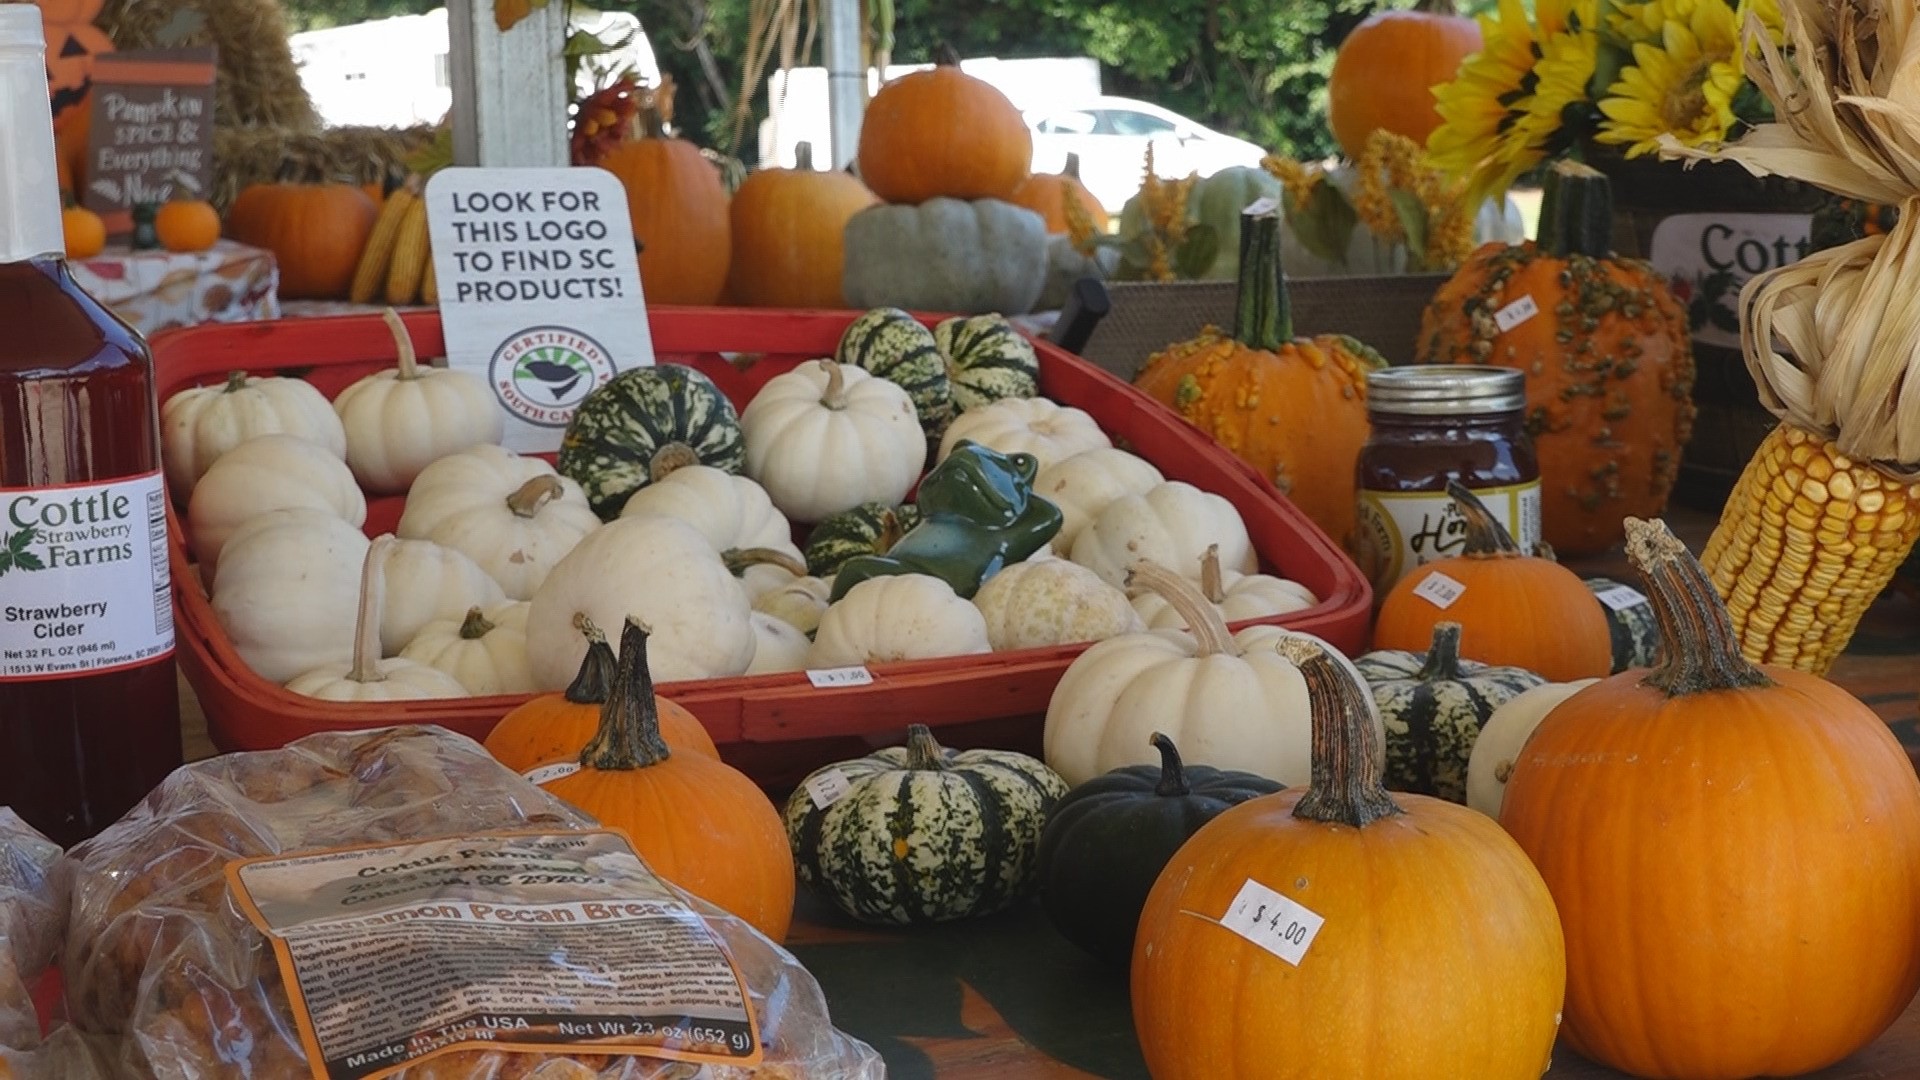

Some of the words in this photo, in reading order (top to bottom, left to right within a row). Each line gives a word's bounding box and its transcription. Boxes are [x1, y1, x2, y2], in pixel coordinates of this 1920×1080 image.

[452, 192, 535, 213] LOOK
[542, 191, 600, 212] FOR
[452, 221, 518, 242] THIS
[526, 220, 607, 241] LOGO
[453, 251, 493, 273] TO
[502, 250, 572, 271] FIND
[579, 249, 616, 270] SC
[1702, 224, 1810, 275] Cott
[456, 277, 624, 303] PRODUCTS!
[503, 333, 599, 361] CERTIFIED
[500, 380, 545, 420] SOUTH
[9, 489, 130, 529] Cottle
[35, 523, 133, 545] Strawberry
[1410, 513, 1468, 553] Hon
[48, 541, 133, 569] Farms
[5, 601, 108, 622] Strawberry
[33, 623, 85, 640] Cider
[4, 650, 23, 660] Net
[25, 649, 38, 659] 32
[42, 648, 55, 657] FL
[58, 645, 74, 656] OZ
[77, 643, 99, 656] (946
[34, 664, 45, 672] W
[358, 855, 452, 878] Cottle
[456, 849, 553, 861] Farms
[476, 874, 511, 887] SC
[469, 903, 577, 922] Pecan
[582, 902, 685, 921] Bread
[295, 946, 347, 961] Vegetable
[351, 935, 409, 949] Shortening
[300, 963, 323, 973] Acid
[301, 975, 325, 985] with
[328, 967, 350, 979] BHT
[355, 961, 375, 971] and
[332, 971, 374, 987] Colored
[376, 964, 398, 975] with
[314, 1012, 343, 1025] Citric
[347, 1002, 371, 1013] Acid
[319, 1016, 367, 1033] Ascorbic
[346, 1044, 405, 1068] Made
[411, 1034, 431, 1047] In
[437, 1020, 477, 1037] The
[483, 1016, 530, 1030] USA
[559, 1021, 594, 1035] Net
[599, 1021, 627, 1035] Wt
[632, 1022, 656, 1037] 23
[661, 1025, 684, 1039] oz
[688, 1027, 727, 1046] (652
[732, 1031, 752, 1050] g)
